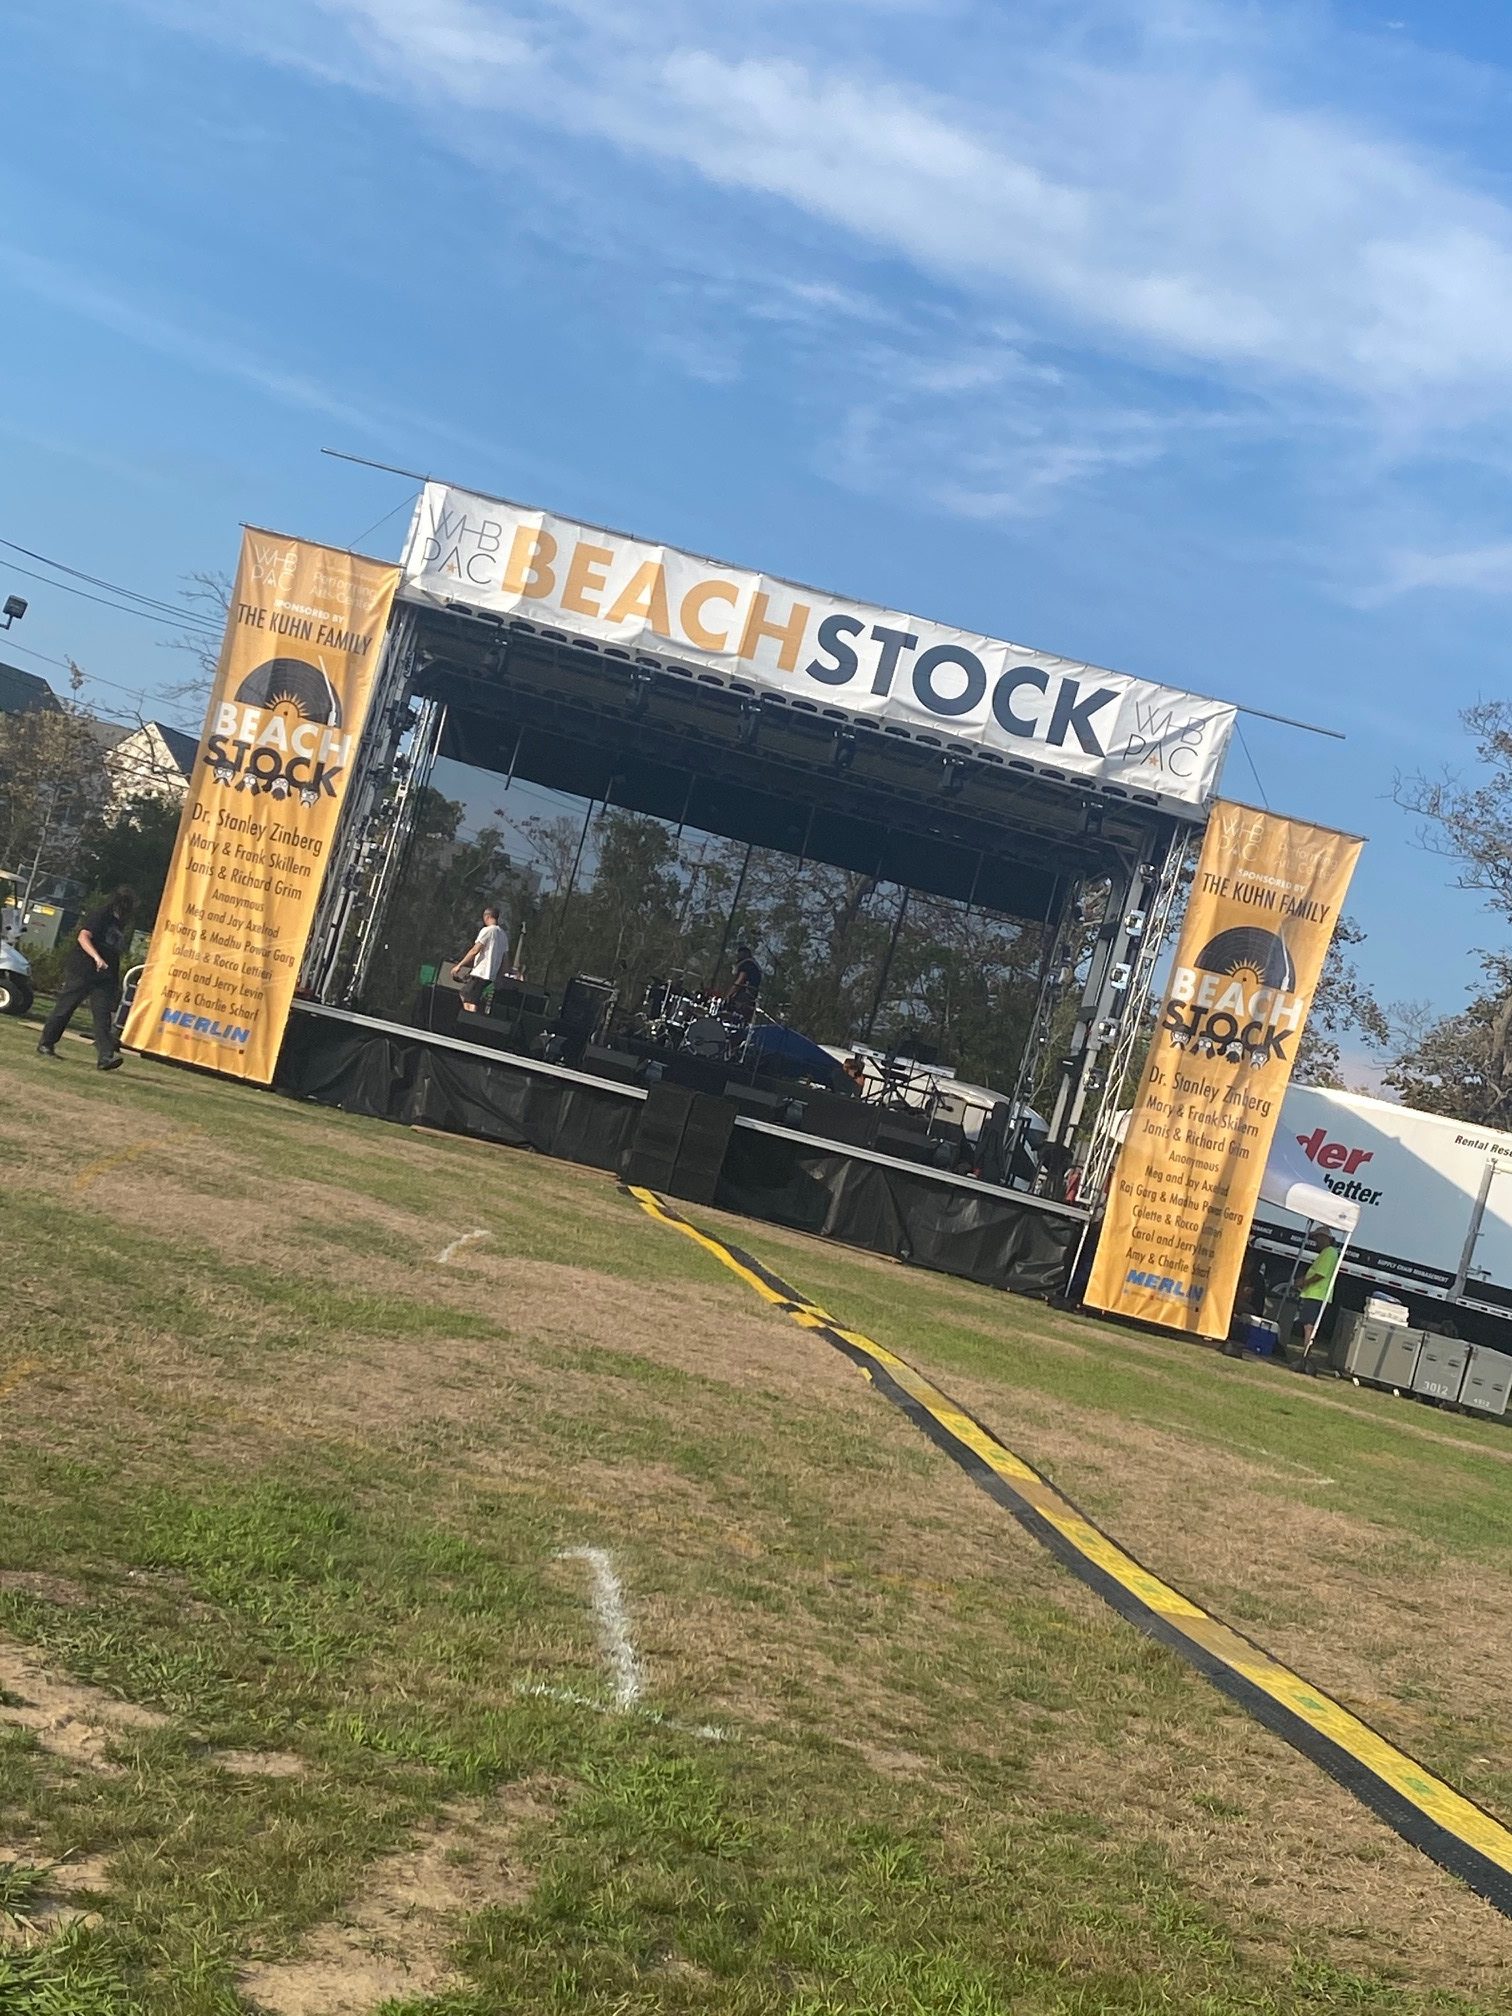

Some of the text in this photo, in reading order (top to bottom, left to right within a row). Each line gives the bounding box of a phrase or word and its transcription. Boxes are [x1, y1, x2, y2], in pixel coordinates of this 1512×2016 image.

[429, 504, 502, 552] WHB
[422, 537, 496, 585] PAC
[238, 603, 373, 656] THE KUHN FAMILY
[214, 702, 352, 767] BEACH
[1134, 701, 1206, 746] WHB
[203, 735, 344, 798] STOCK
[1123, 734, 1199, 778] PAC
[192, 802, 324, 857] Dr. Stanley Zinberg
[189, 832, 311, 877] Mary & Frank Skillern
[186, 856, 302, 900] Janis & Richard Grim
[211, 889, 264, 912] Anonymous
[1202, 872, 1330, 924] THE KUHN FAMILY
[185, 903, 205, 921] Meg
[207, 909, 226, 924] and
[226, 913, 244, 932] Jay
[200, 929, 207, 940] &
[210, 931, 241, 950] Madhu
[273, 949, 296, 967] Garg
[203, 952, 210, 964] &
[213, 953, 240, 971] Rocco
[193, 972, 212, 986] and
[212, 974, 237, 995] Jerry
[239, 984, 264, 1000] Levin
[1171, 967, 1304, 1031] BEACH
[161, 1007, 251, 1043] MERLIN
[183, 991, 191, 1003] &
[194, 993, 227, 1012] Charlie
[229, 1002, 260, 1021] Scharf
[1162, 1001, 1295, 1061] STOCK
[1149, 1065, 1166, 1087] Dr.
[1172, 1072, 1220, 1104] Stanley
[1146, 1095, 1175, 1118] Mary
[1176, 1104, 1184, 1118] &
[1188, 1105, 1218, 1127] Frank
[1142, 1119, 1171, 1140] Janis
[1173, 1127, 1181, 1141] &
[1185, 1129, 1226, 1152] Richard
[1454, 1135, 1489, 1150] Rental
[1145, 1165, 1163, 1183] Meg
[1165, 1173, 1184, 1186] and
[1185, 1174, 1200, 1191] Jay
[1119, 1179, 1133, 1196] Raj
[1136, 1184, 1157, 1203] Garg
[1160, 1191, 1167, 1202] &
[1169, 1193, 1199, 1211] Madhu
[1223, 1206, 1244, 1226] Garg
[1132, 1204, 1161, 1223] Colette
[1164, 1213, 1172, 1225] &
[1175, 1214, 1199, 1232] Rocco
[1132, 1225, 1155, 1242] Carol
[1156, 1234, 1175, 1248] and
[1175, 1236, 1197, 1256] Jerry
[1125, 1247, 1145, 1263] Amy
[1147, 1252, 1155, 1265] &
[1158, 1254, 1189, 1273] Charlie
[1423, 1381, 1449, 1395] 3012
